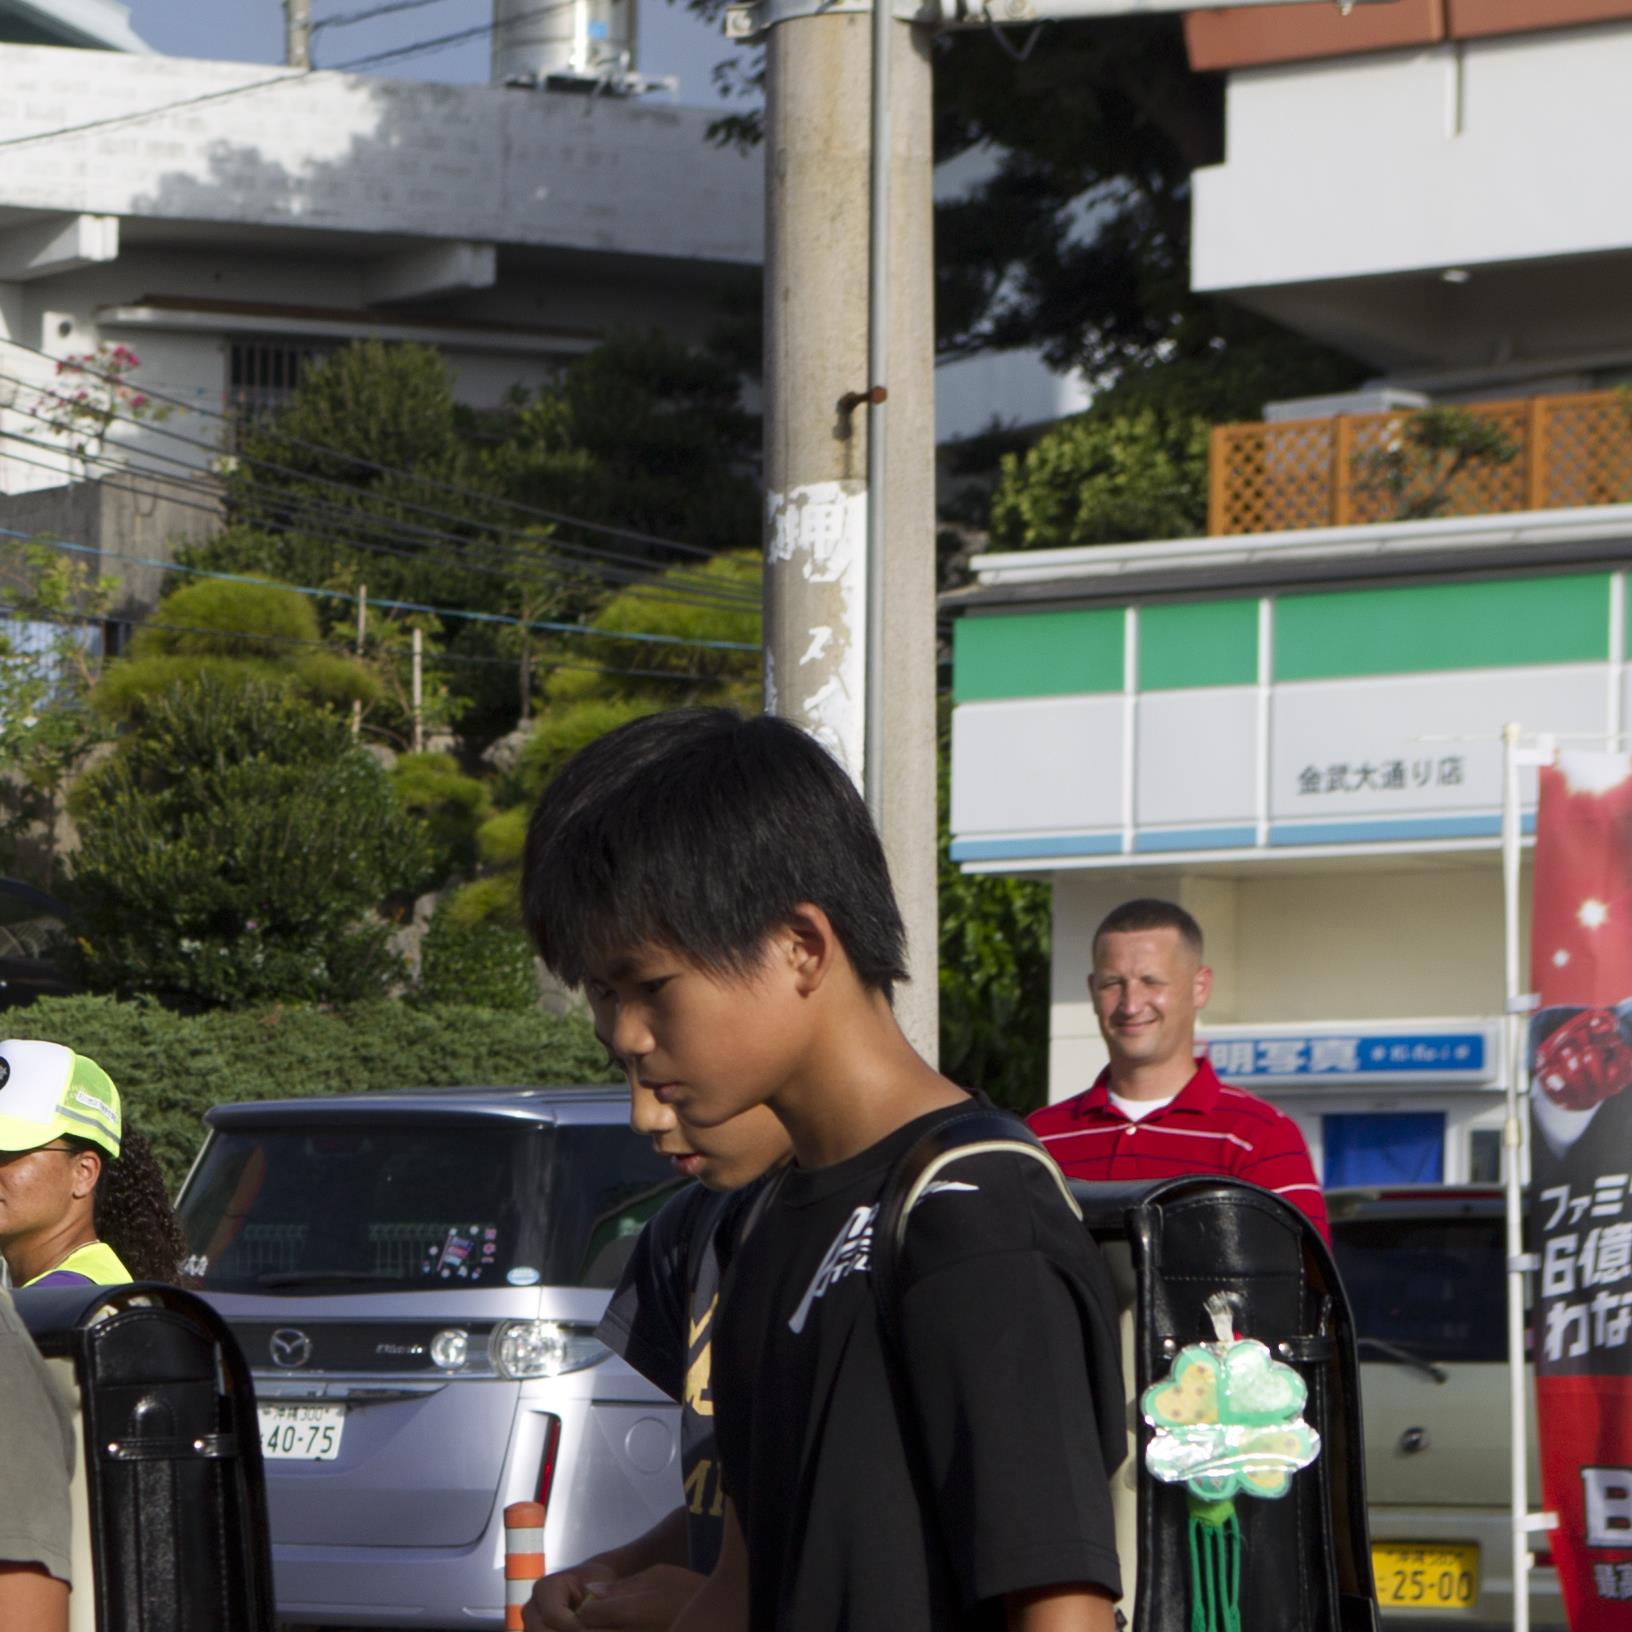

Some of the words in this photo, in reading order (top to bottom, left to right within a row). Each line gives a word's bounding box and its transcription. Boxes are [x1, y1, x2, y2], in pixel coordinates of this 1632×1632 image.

[1297, 755, 1463, 795] 金武大通り店
[1194, 1038, 1359, 1073] 明写真
[1540, 1174, 1632, 1231] ファミ
[1542, 1223, 1632, 1298] 6億
[267, 1425, 335, 1453] 40-75
[1392, 1570, 1473, 1602] 25-00
